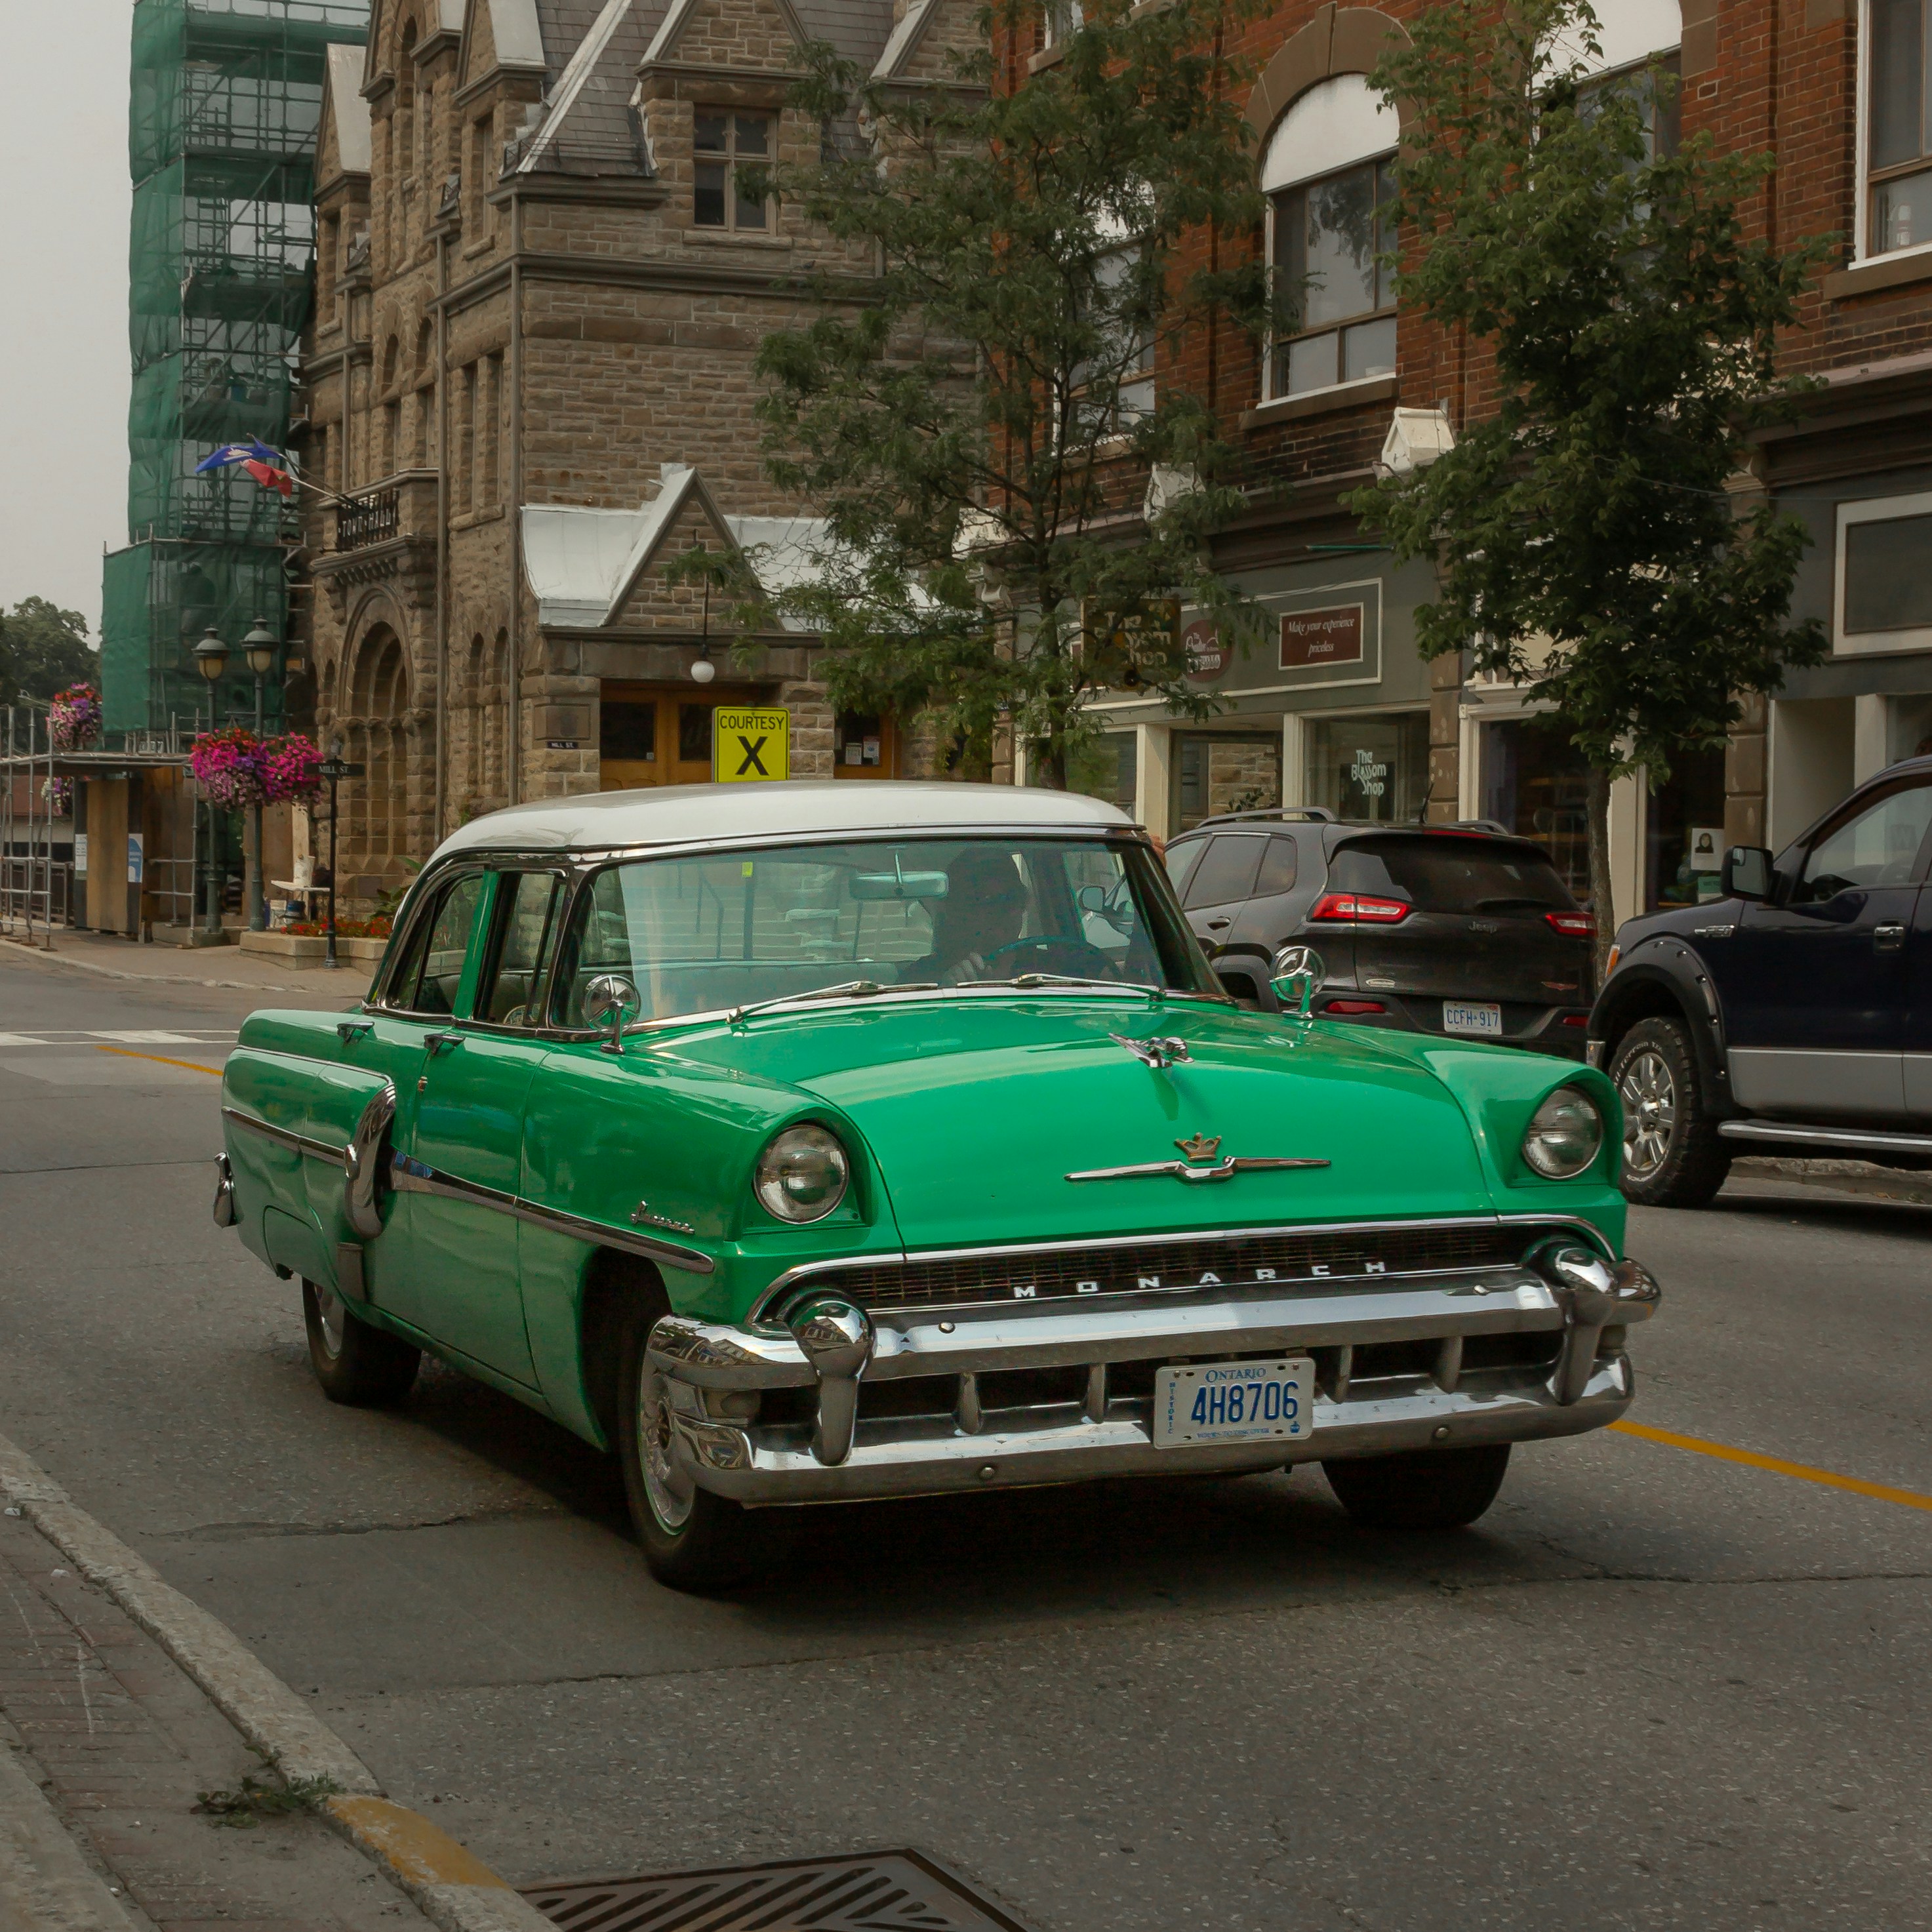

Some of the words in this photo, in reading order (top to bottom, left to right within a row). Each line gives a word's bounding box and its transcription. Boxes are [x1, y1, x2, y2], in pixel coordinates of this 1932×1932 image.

[342, 515, 363, 537] TOWN
[368, 509, 391, 531] HALL
[1288, 620, 1306, 635] Make
[1304, 622, 1322, 635] your
[1322, 615, 1356, 634] experience
[1308, 640, 1335, 658] priceless
[719, 715, 785, 730] COURTESY
[734, 735, 771, 776] X
[1356, 750, 1373, 765] The
[318, 765, 337, 774] MILL
[1351, 763, 1387, 781] Blossom
[1361, 780, 1384, 796] Shop
[1468, 921, 1499, 934] Jeep
[1013, 1261, 1386, 1298] MONARCH
[1191, 1379, 1300, 1424] 4H8706
